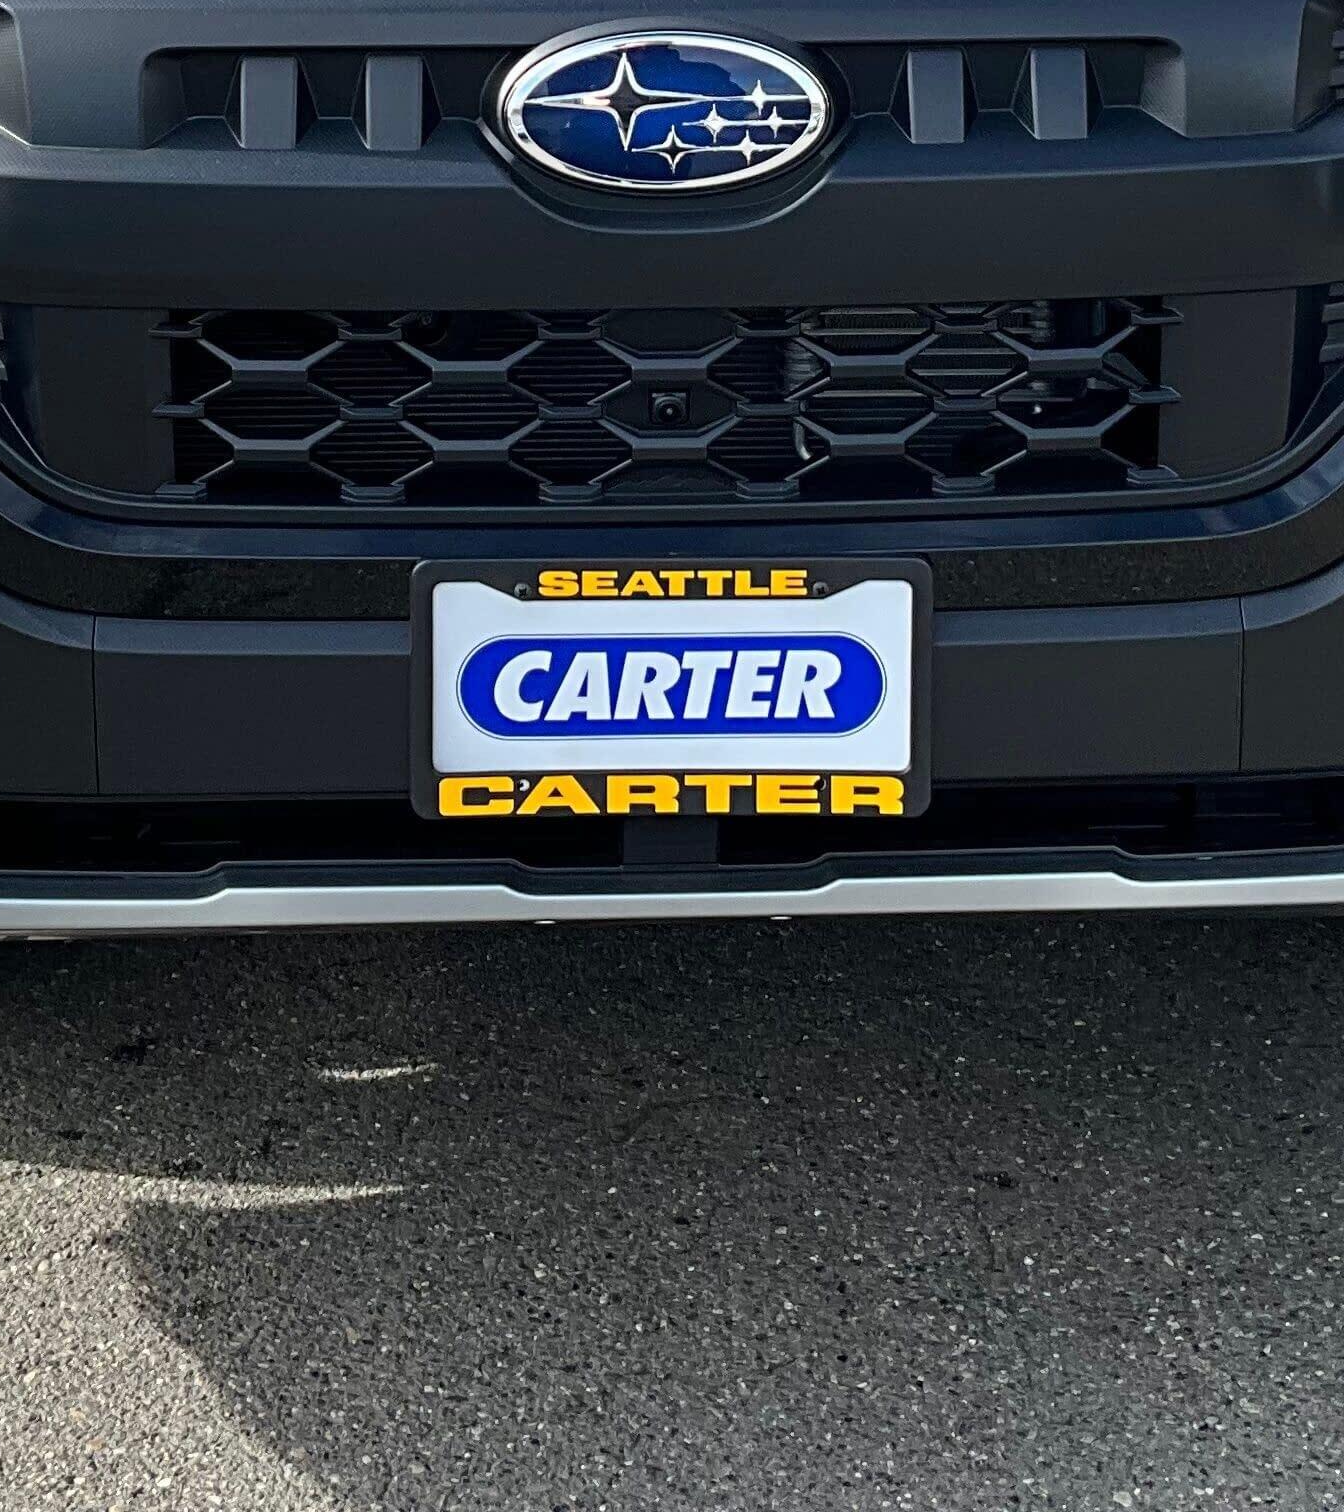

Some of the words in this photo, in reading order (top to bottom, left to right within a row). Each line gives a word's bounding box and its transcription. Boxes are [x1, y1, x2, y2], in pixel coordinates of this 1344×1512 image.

[537, 569, 809, 598] SEATTLE
[493, 649, 843, 723] CARTER
[437, 774, 906, 817] CARTER
